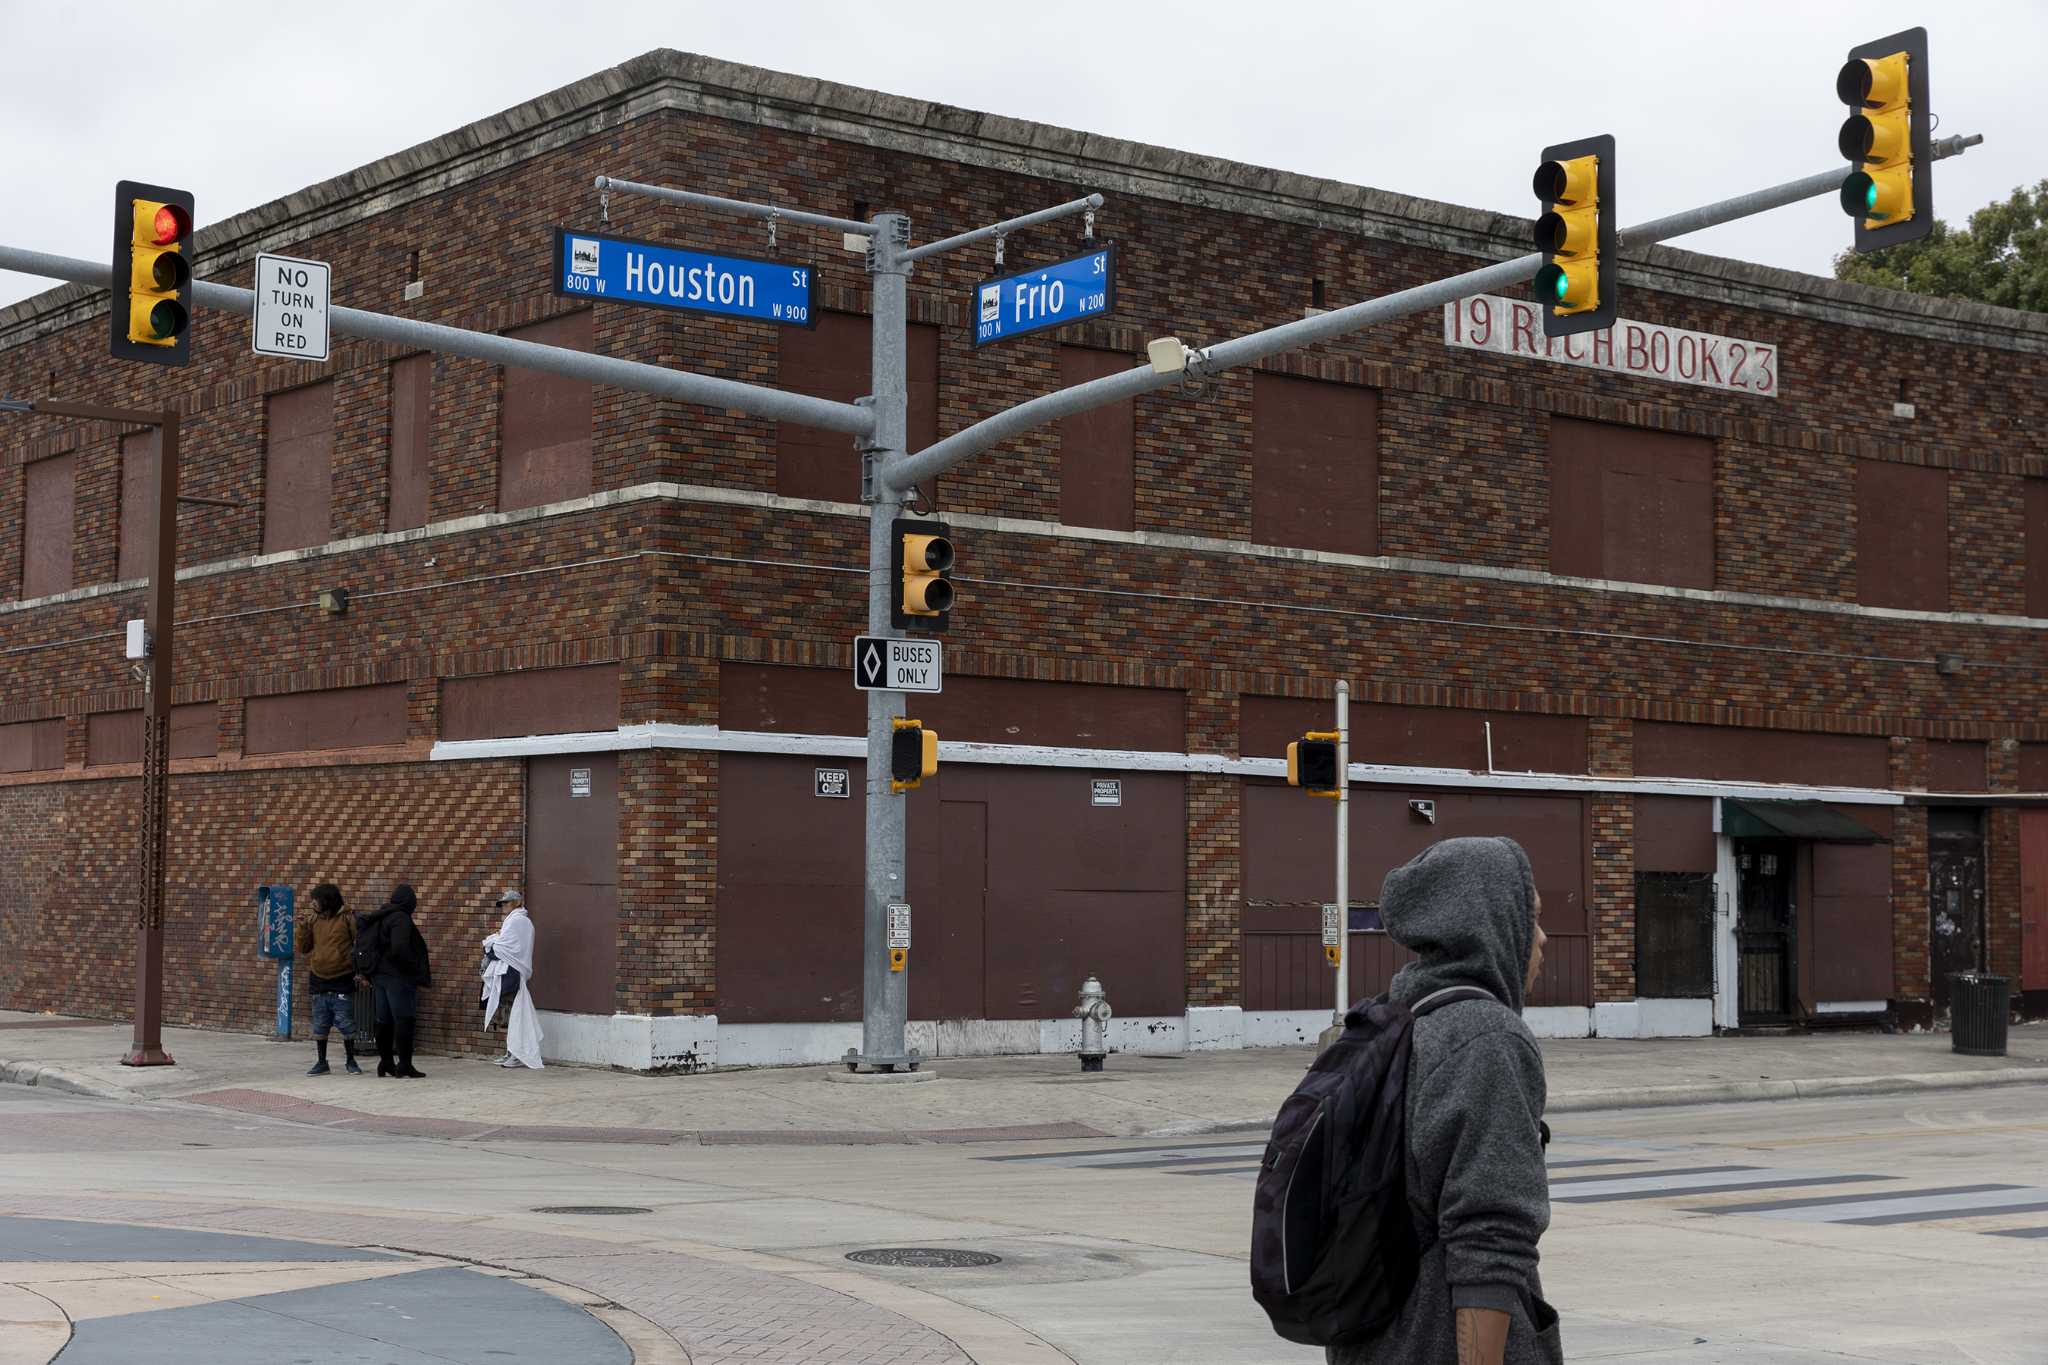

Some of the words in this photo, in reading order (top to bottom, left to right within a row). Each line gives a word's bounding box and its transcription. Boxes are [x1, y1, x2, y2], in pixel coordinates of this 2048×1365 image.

[278, 266, 309, 288] NO
[567, 274, 590, 292] 800
[596, 279, 606, 294] W
[626, 252, 754, 308] Houston
[792, 270, 807, 288] St
[1015, 273, 1064, 323] Frio
[1093, 255, 1105, 274] St
[272, 289, 314, 310] TURN
[1079, 298, 1086, 312] N
[1088, 292, 1105, 310] 200
[281, 312, 303, 329] ON
[772, 303, 782, 317] W
[786, 304, 807, 321] 900
[979, 322, 993, 338] 100
[995, 320, 1001, 334] N
[1453, 297, 1492, 346] 19
[275, 332, 307, 350] RED
[893, 646, 932, 664] BUSES
[897, 667, 928, 684] ONLY
[819, 771, 845, 783] KEEP
[1094, 788, 1118, 796] PROPERTY
